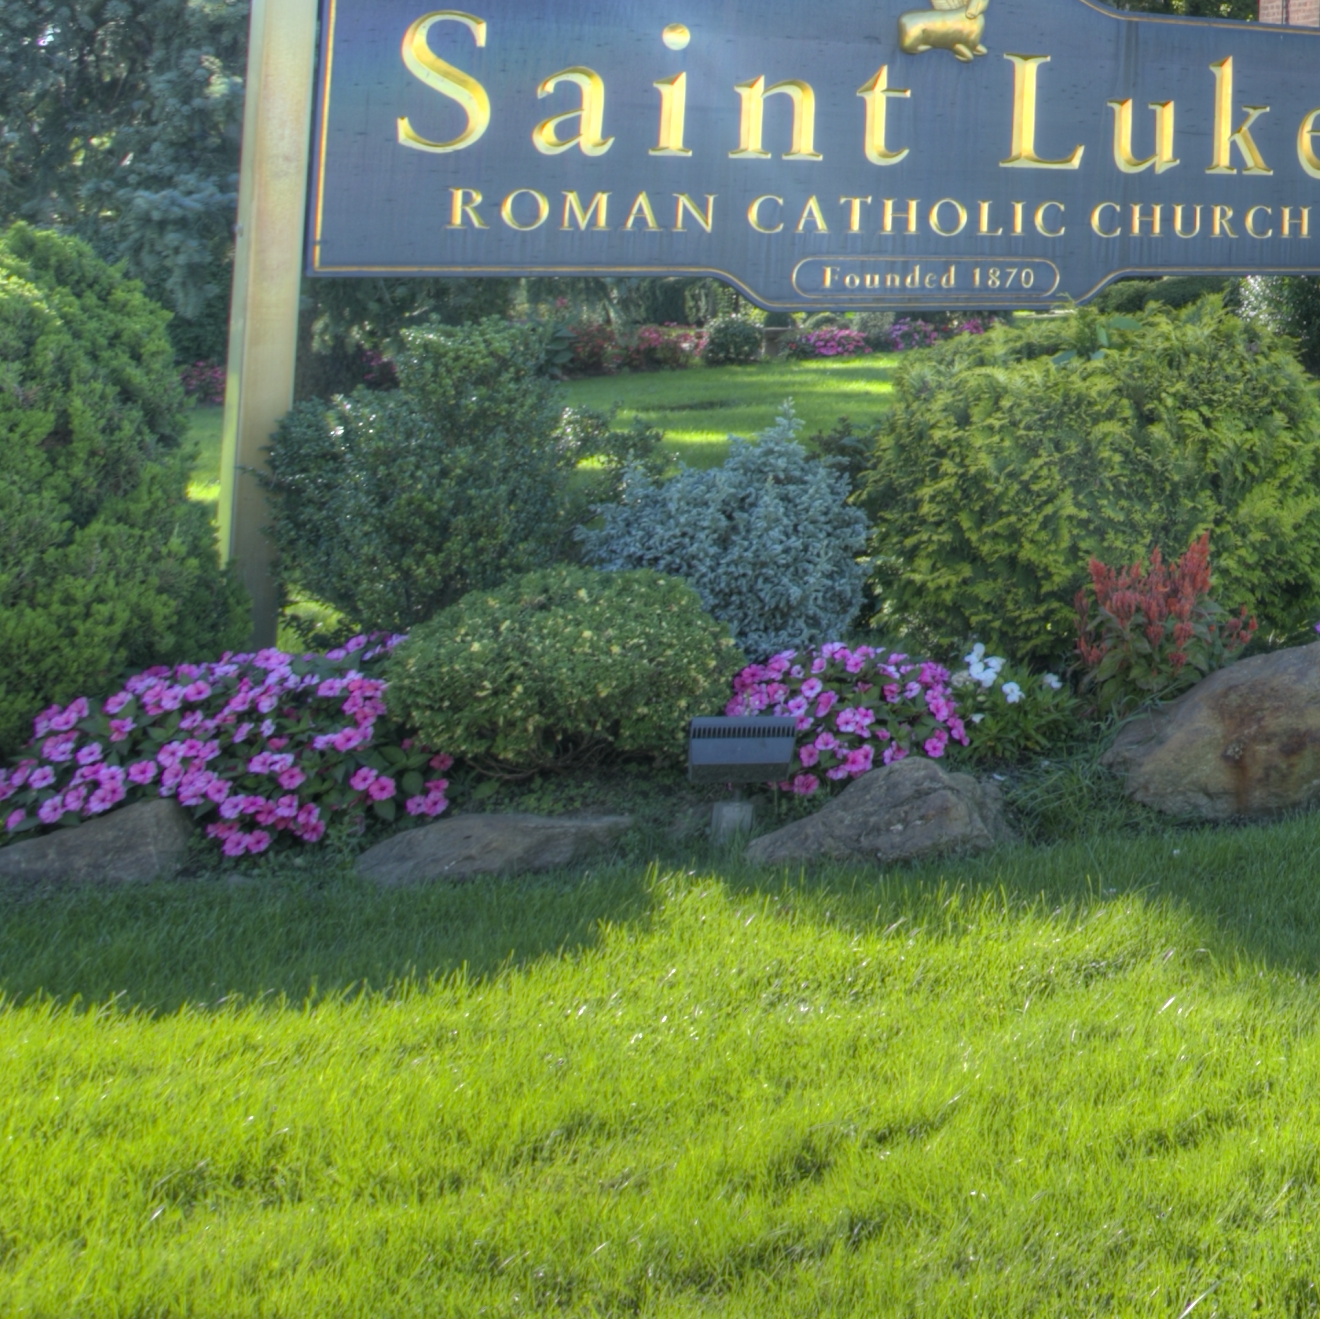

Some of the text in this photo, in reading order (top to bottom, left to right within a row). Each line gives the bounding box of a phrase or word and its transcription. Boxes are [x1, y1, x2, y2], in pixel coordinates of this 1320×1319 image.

[396, 9, 911, 166] Saint
[446, 187, 1312, 238] ROMAN CATHOLIC CHURCH
[821, 264, 1034, 289] Founded 1870
